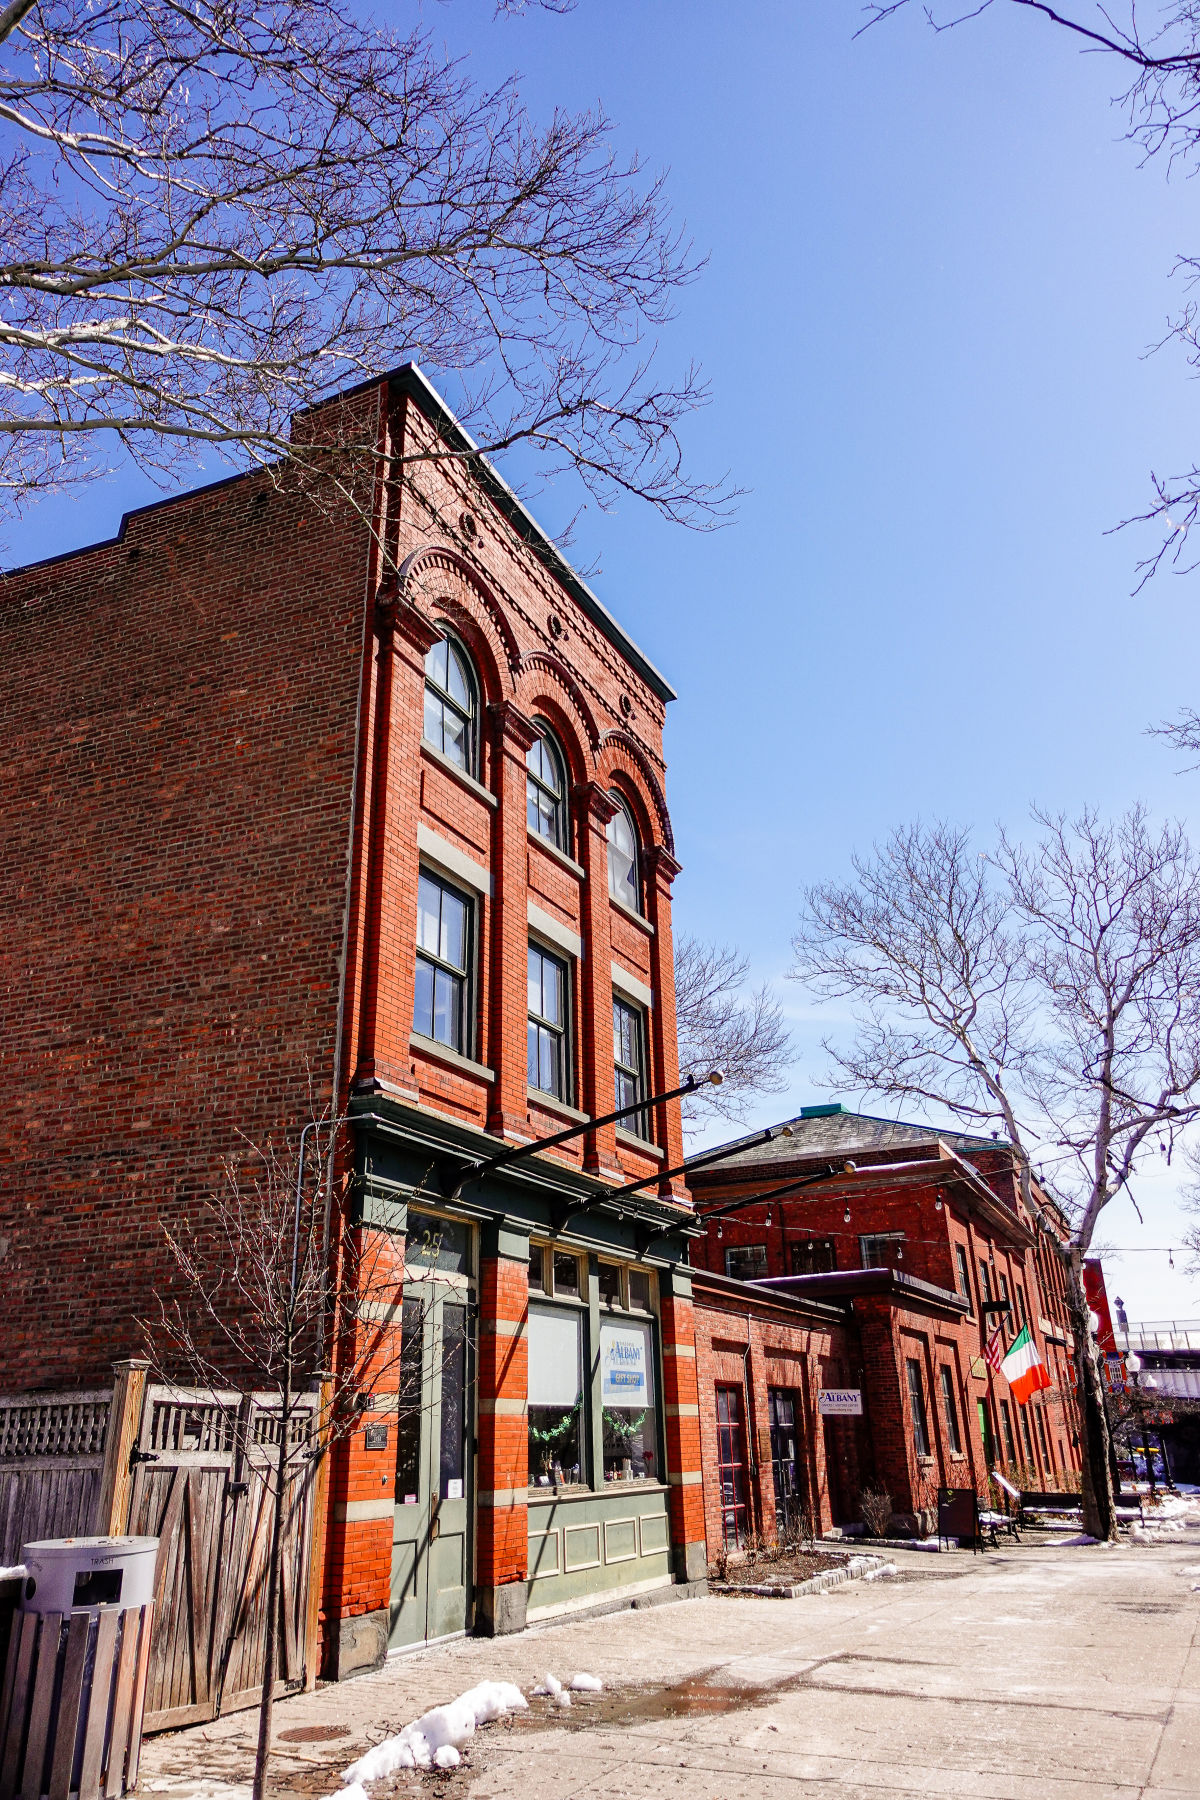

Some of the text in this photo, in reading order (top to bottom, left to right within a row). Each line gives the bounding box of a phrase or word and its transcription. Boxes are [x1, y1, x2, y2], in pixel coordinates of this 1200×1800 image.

[422, 1230, 440, 1257] 25
[616, 1341, 640, 1360] ALBANY
[615, 1373, 640, 1384] GIFT SHOP
[826, 1392, 857, 1402] ALBANY
[90, 1558, 114, 1566] TRASH
